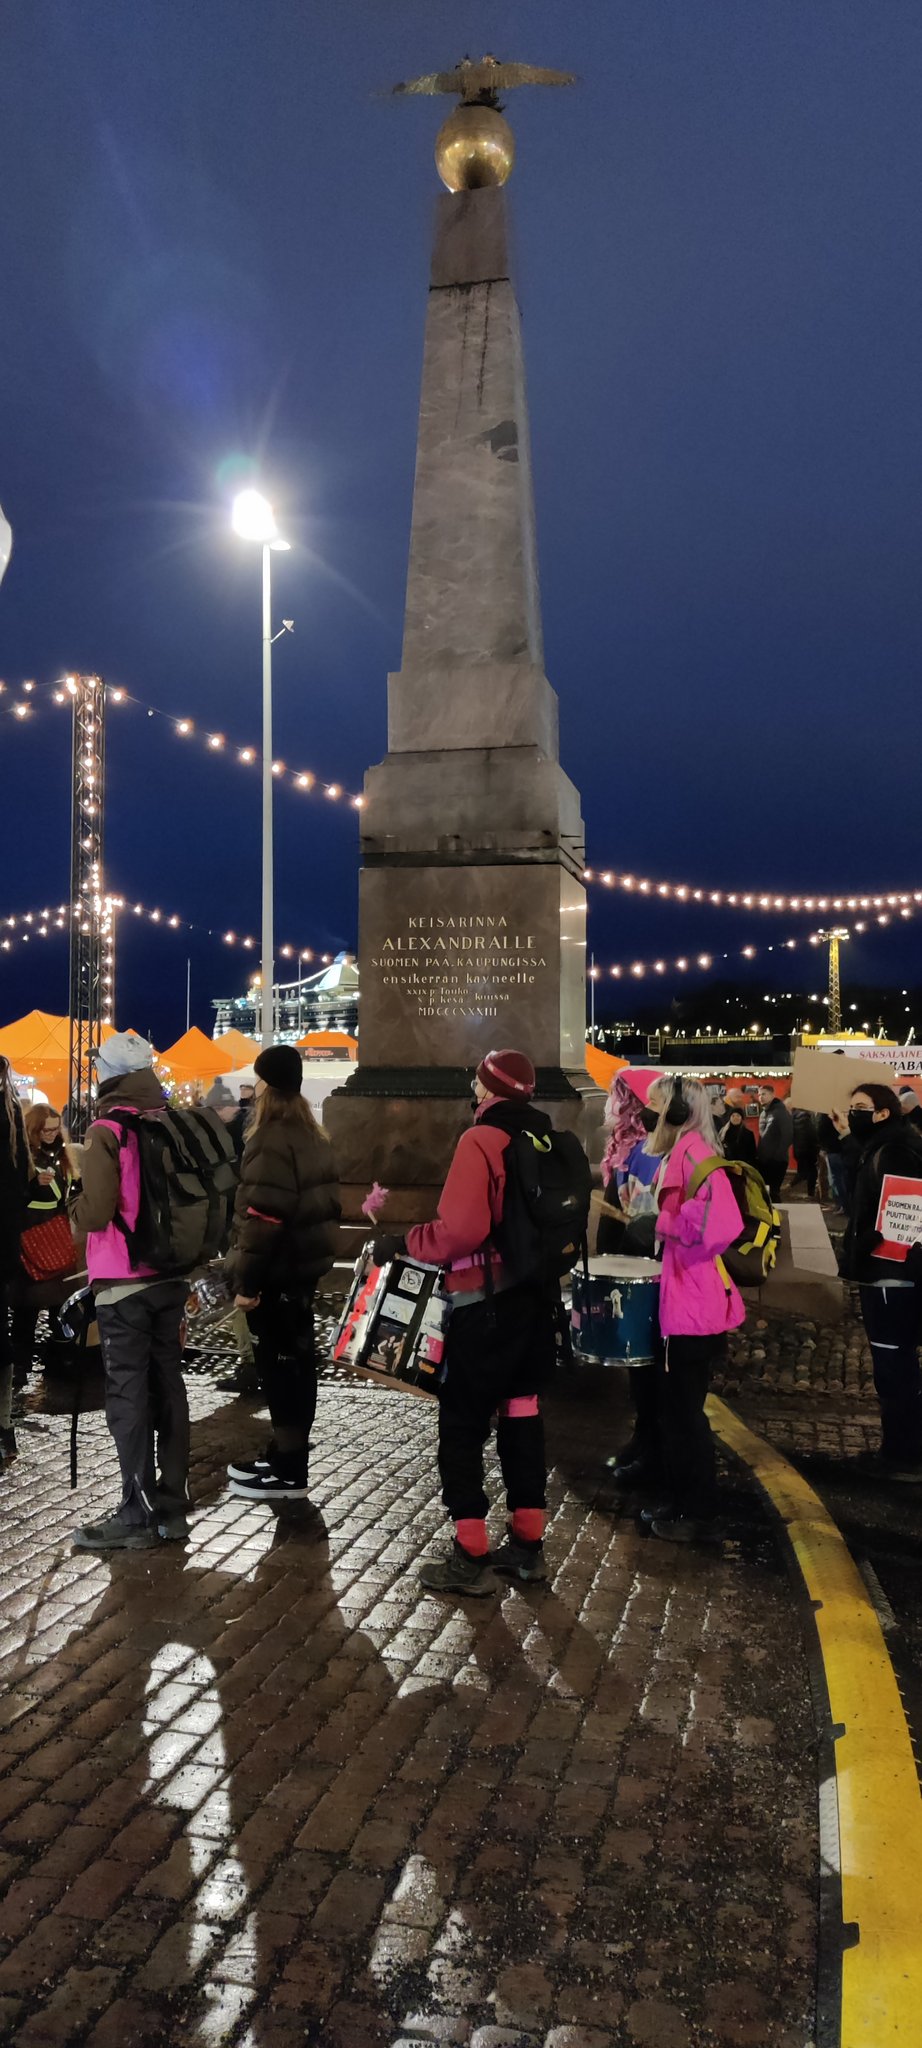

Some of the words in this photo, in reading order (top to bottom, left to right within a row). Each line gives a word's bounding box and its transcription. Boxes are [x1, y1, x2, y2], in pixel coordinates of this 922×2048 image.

[408, 916, 508, 929] KEISARINNA
[382, 935, 537, 951] ALEXANDRALLE
[370, 957, 420, 967] SUOMEN
[383, 972, 459, 985] ensikerran
[888, 1199, 912, 1211] SUOMEN
